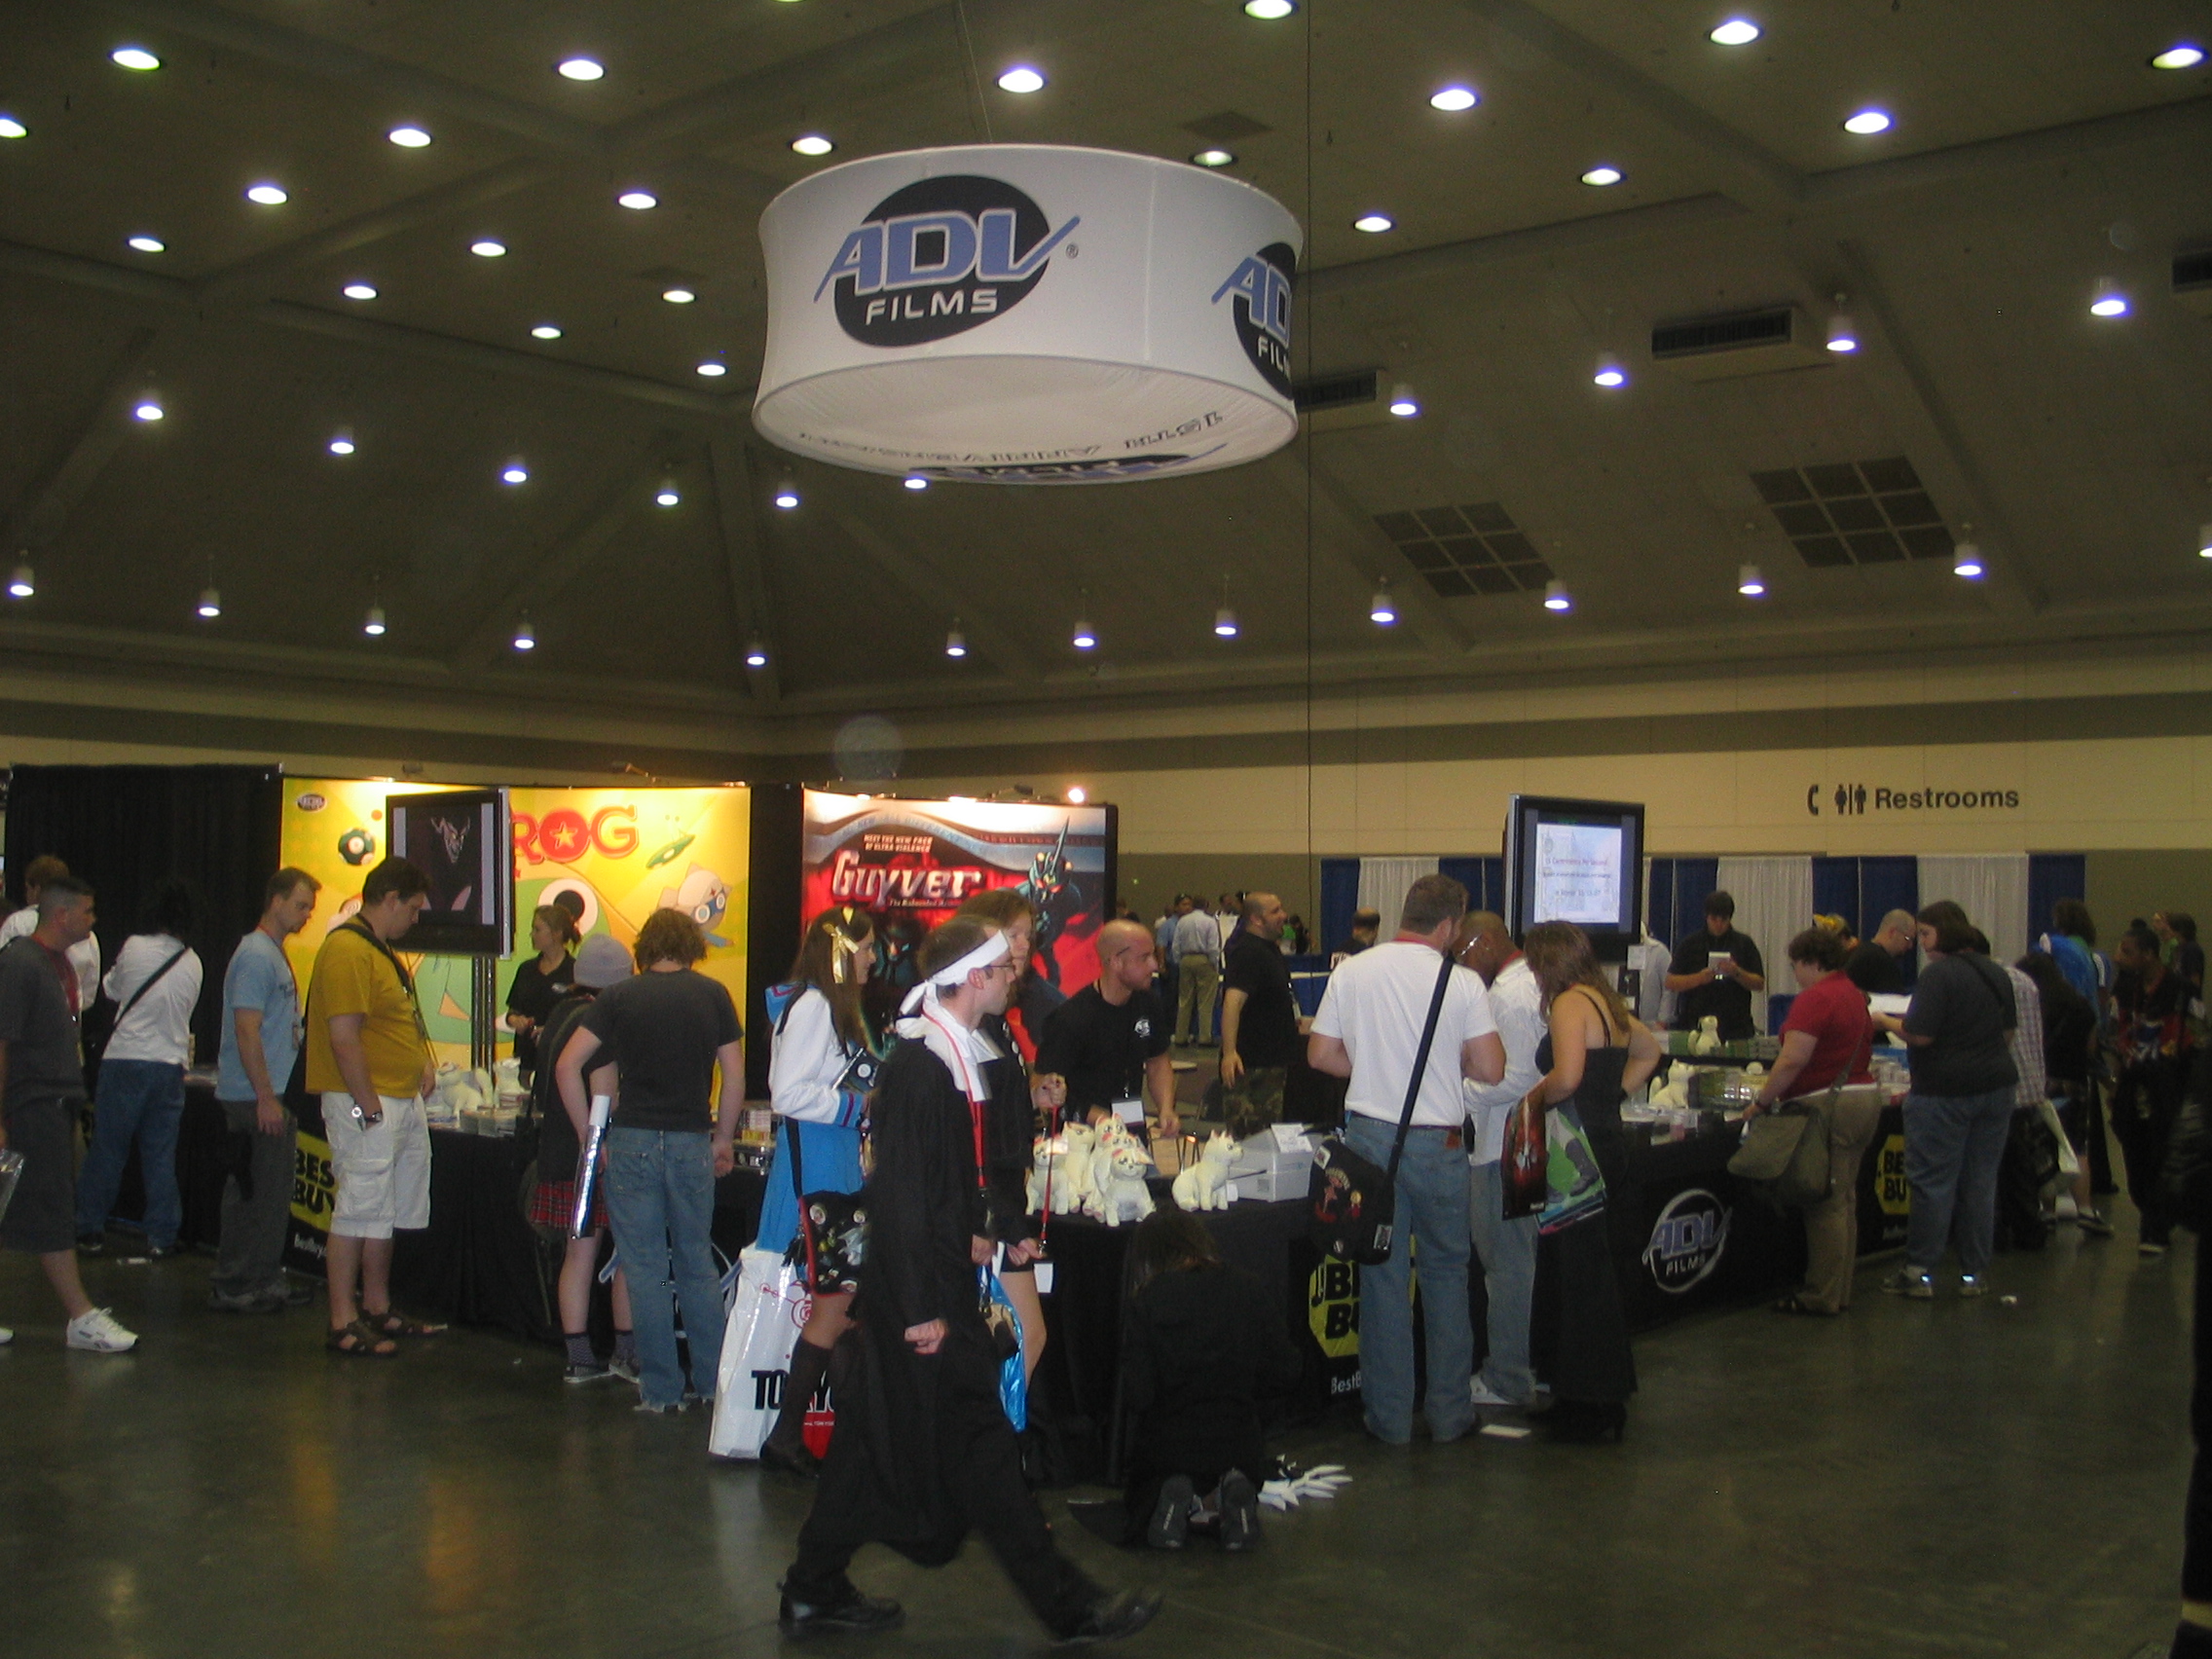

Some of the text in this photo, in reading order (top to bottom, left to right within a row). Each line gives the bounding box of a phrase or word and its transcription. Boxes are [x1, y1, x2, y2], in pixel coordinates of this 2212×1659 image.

[814, 208, 1081, 303] ADV
[866, 288, 999, 326] FILMS
[1211, 256, 1291, 350] AD
[1258, 335, 1292, 380] FIL
[1875, 788, 2019, 809] Restrooms
[512, 804, 640, 866] ROG
[295, 1149, 335, 1189] BES
[1883, 1150, 1905, 1175] BE
[1883, 1176, 1907, 1202] BU
[1666, 1252, 1706, 1276] FILMS
[1331, 1371, 1362, 1395] BestB
